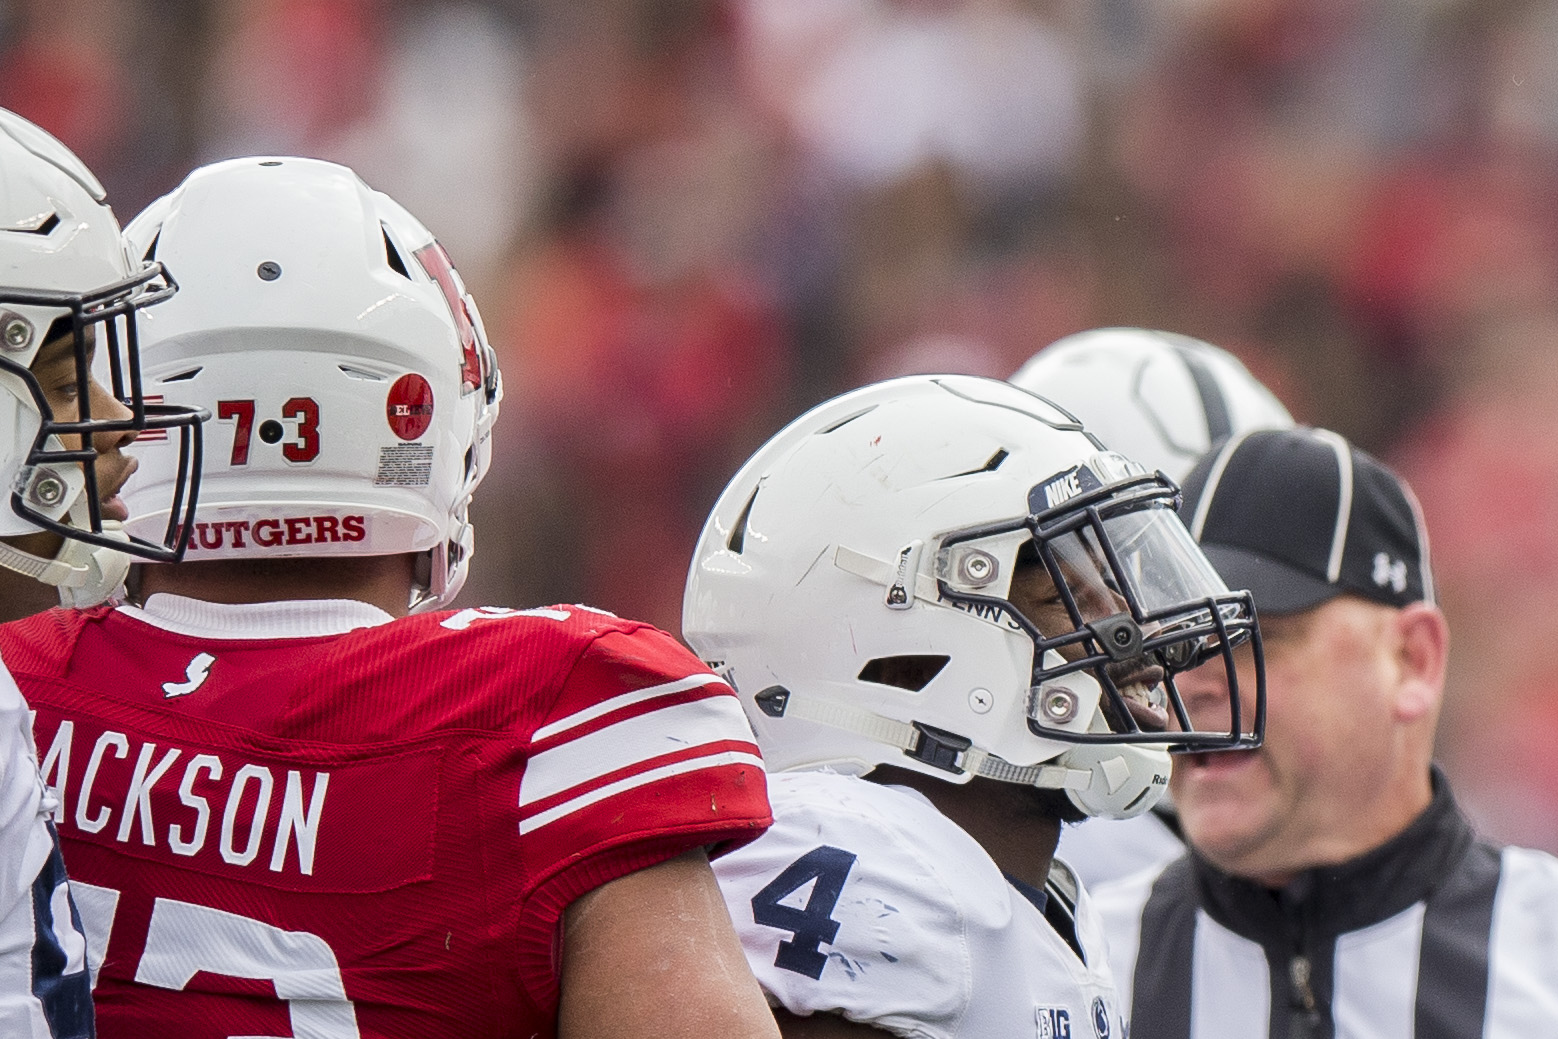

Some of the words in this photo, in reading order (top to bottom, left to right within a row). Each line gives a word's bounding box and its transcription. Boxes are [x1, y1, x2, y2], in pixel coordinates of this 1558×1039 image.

[1044, 471, 1083, 509] NIKE
[937, 592, 1003, 623] NN
[29, 710, 330, 876] ACKSON
[751, 844, 857, 981] 4
